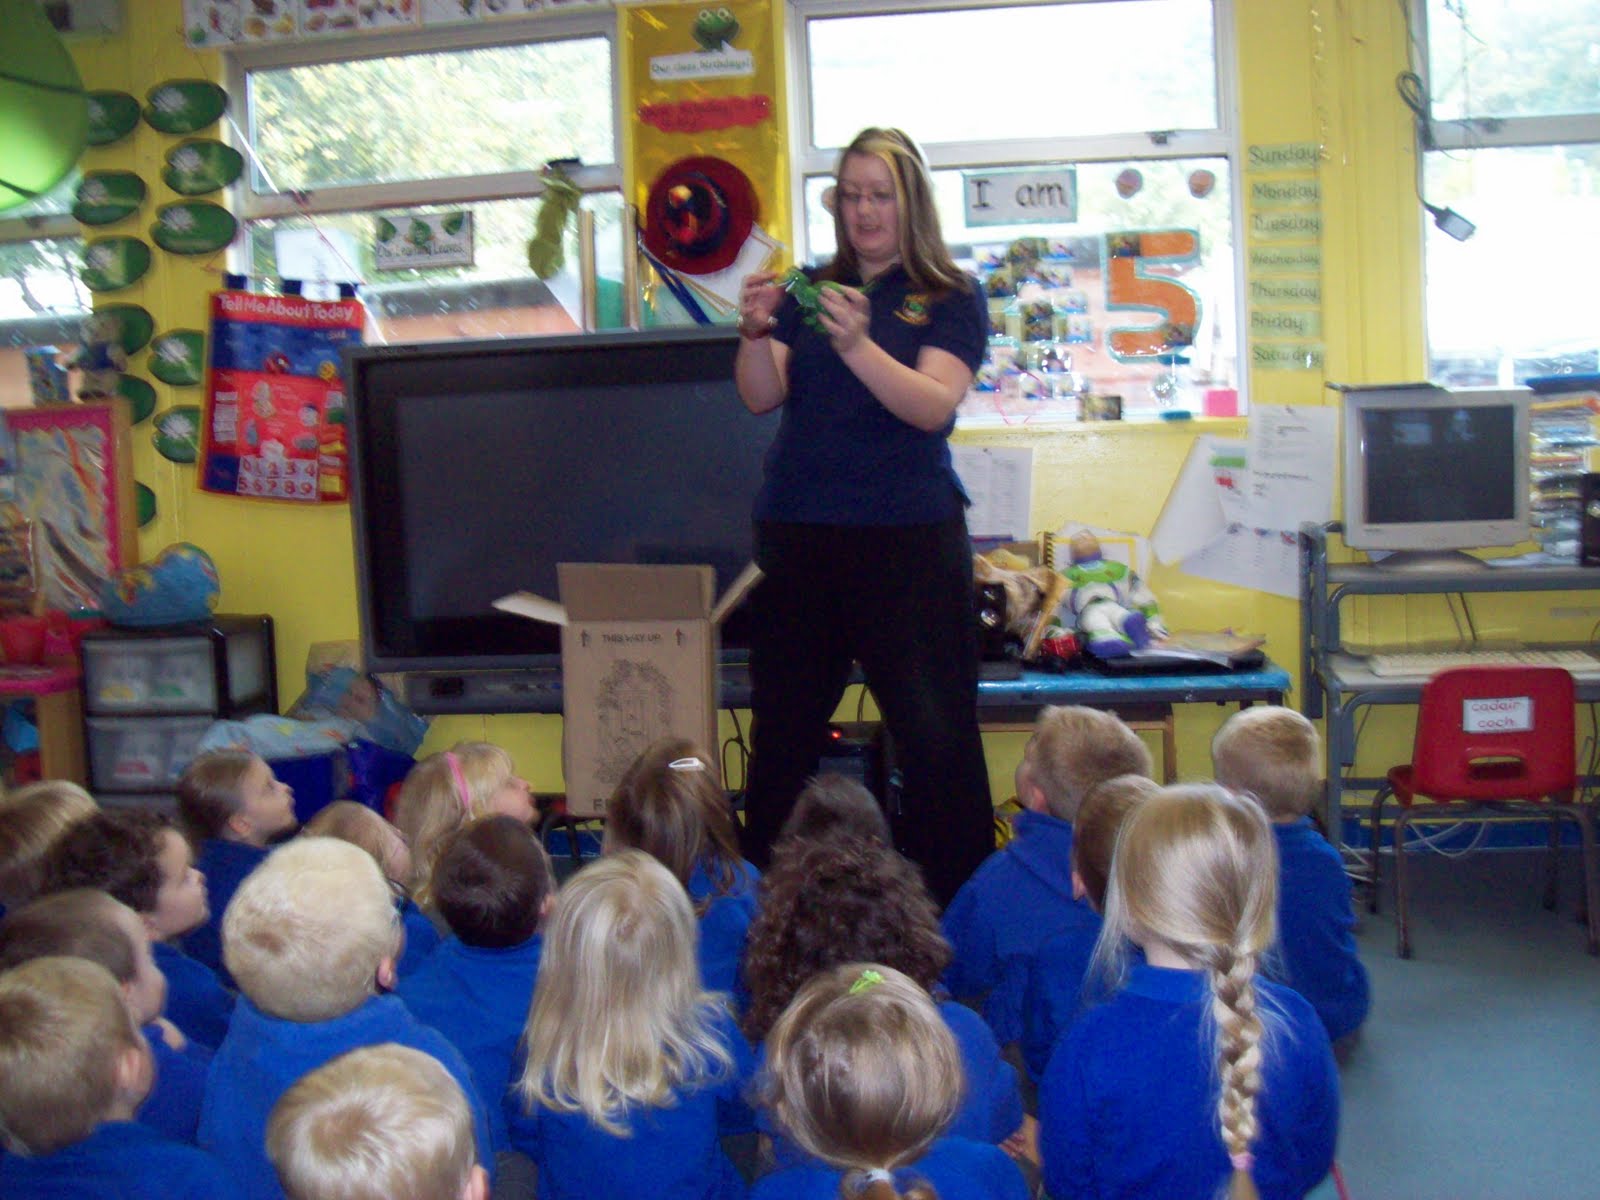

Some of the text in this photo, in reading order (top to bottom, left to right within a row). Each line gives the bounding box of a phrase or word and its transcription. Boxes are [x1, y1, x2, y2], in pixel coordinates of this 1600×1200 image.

[1248, 144, 1320, 168] Sunday
[971, 178, 1069, 209] I am
[1253, 182, 1320, 203] Monday
[1251, 213, 1320, 234] Tuesday
[1250, 252, 1320, 268] Wednesday
[1104, 228, 1203, 364] 5
[1250, 281, 1320, 301] Thursday
[219, 294, 354, 321] Tell Me About Today
[1250, 311, 1305, 335] Friday
[602, 633, 623, 642] THIS
[647, 633, 661, 642] UP
[1477, 716, 1515, 728] coch
